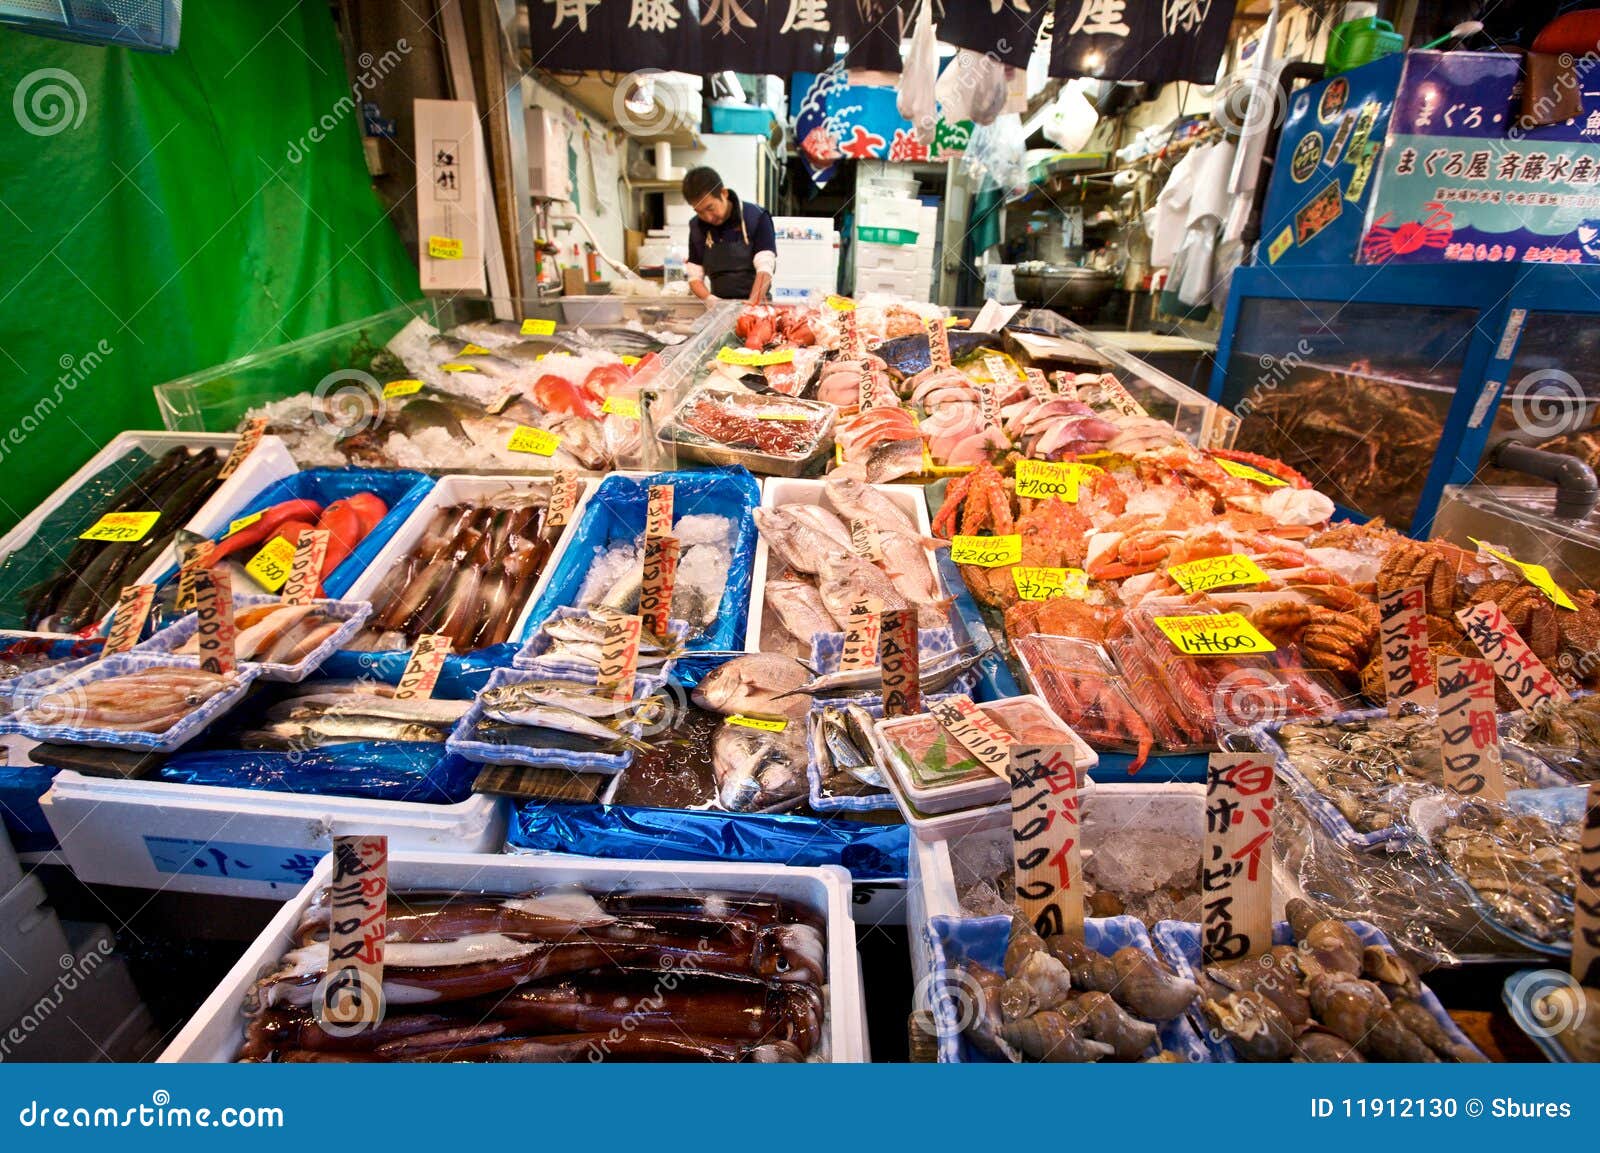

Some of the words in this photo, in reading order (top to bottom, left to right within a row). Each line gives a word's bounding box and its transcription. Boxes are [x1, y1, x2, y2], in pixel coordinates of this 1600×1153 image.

[1498, 151, 1600, 185] 斉藤水産
[1043, 752, 1079, 889] 白バイ
[1226, 759, 1275, 881] 白バイ
